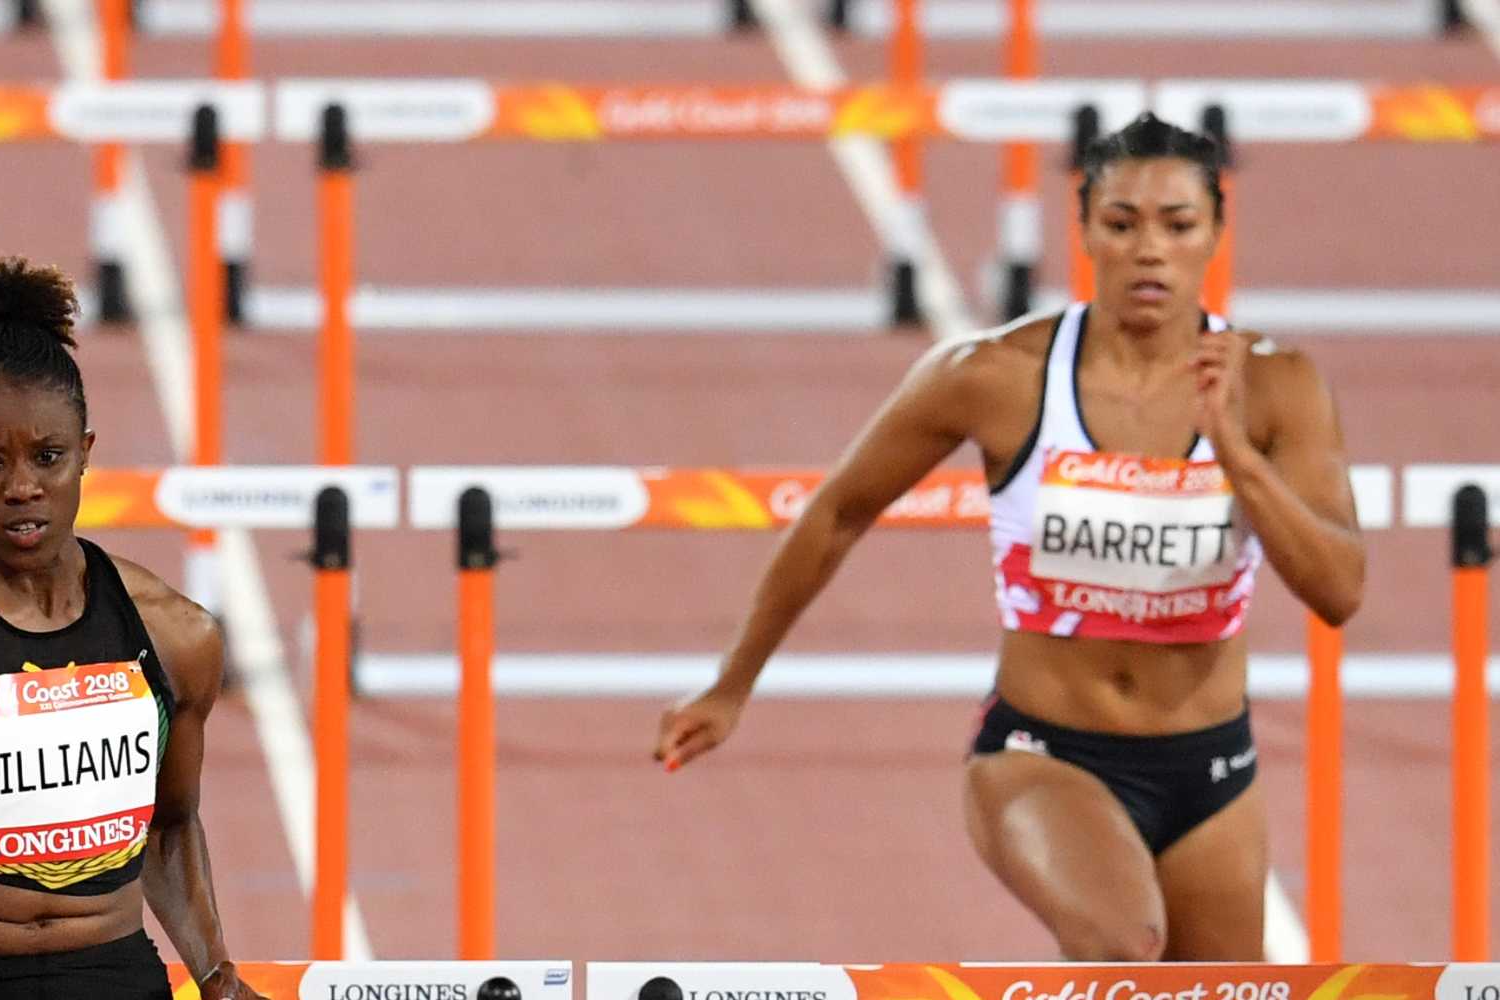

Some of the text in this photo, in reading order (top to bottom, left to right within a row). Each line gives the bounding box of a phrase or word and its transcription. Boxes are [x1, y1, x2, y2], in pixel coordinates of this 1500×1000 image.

[1040, 514, 1231, 567] BARRETT
[22, 678, 80, 704] Coast
[84, 671, 129, 695] 2018
